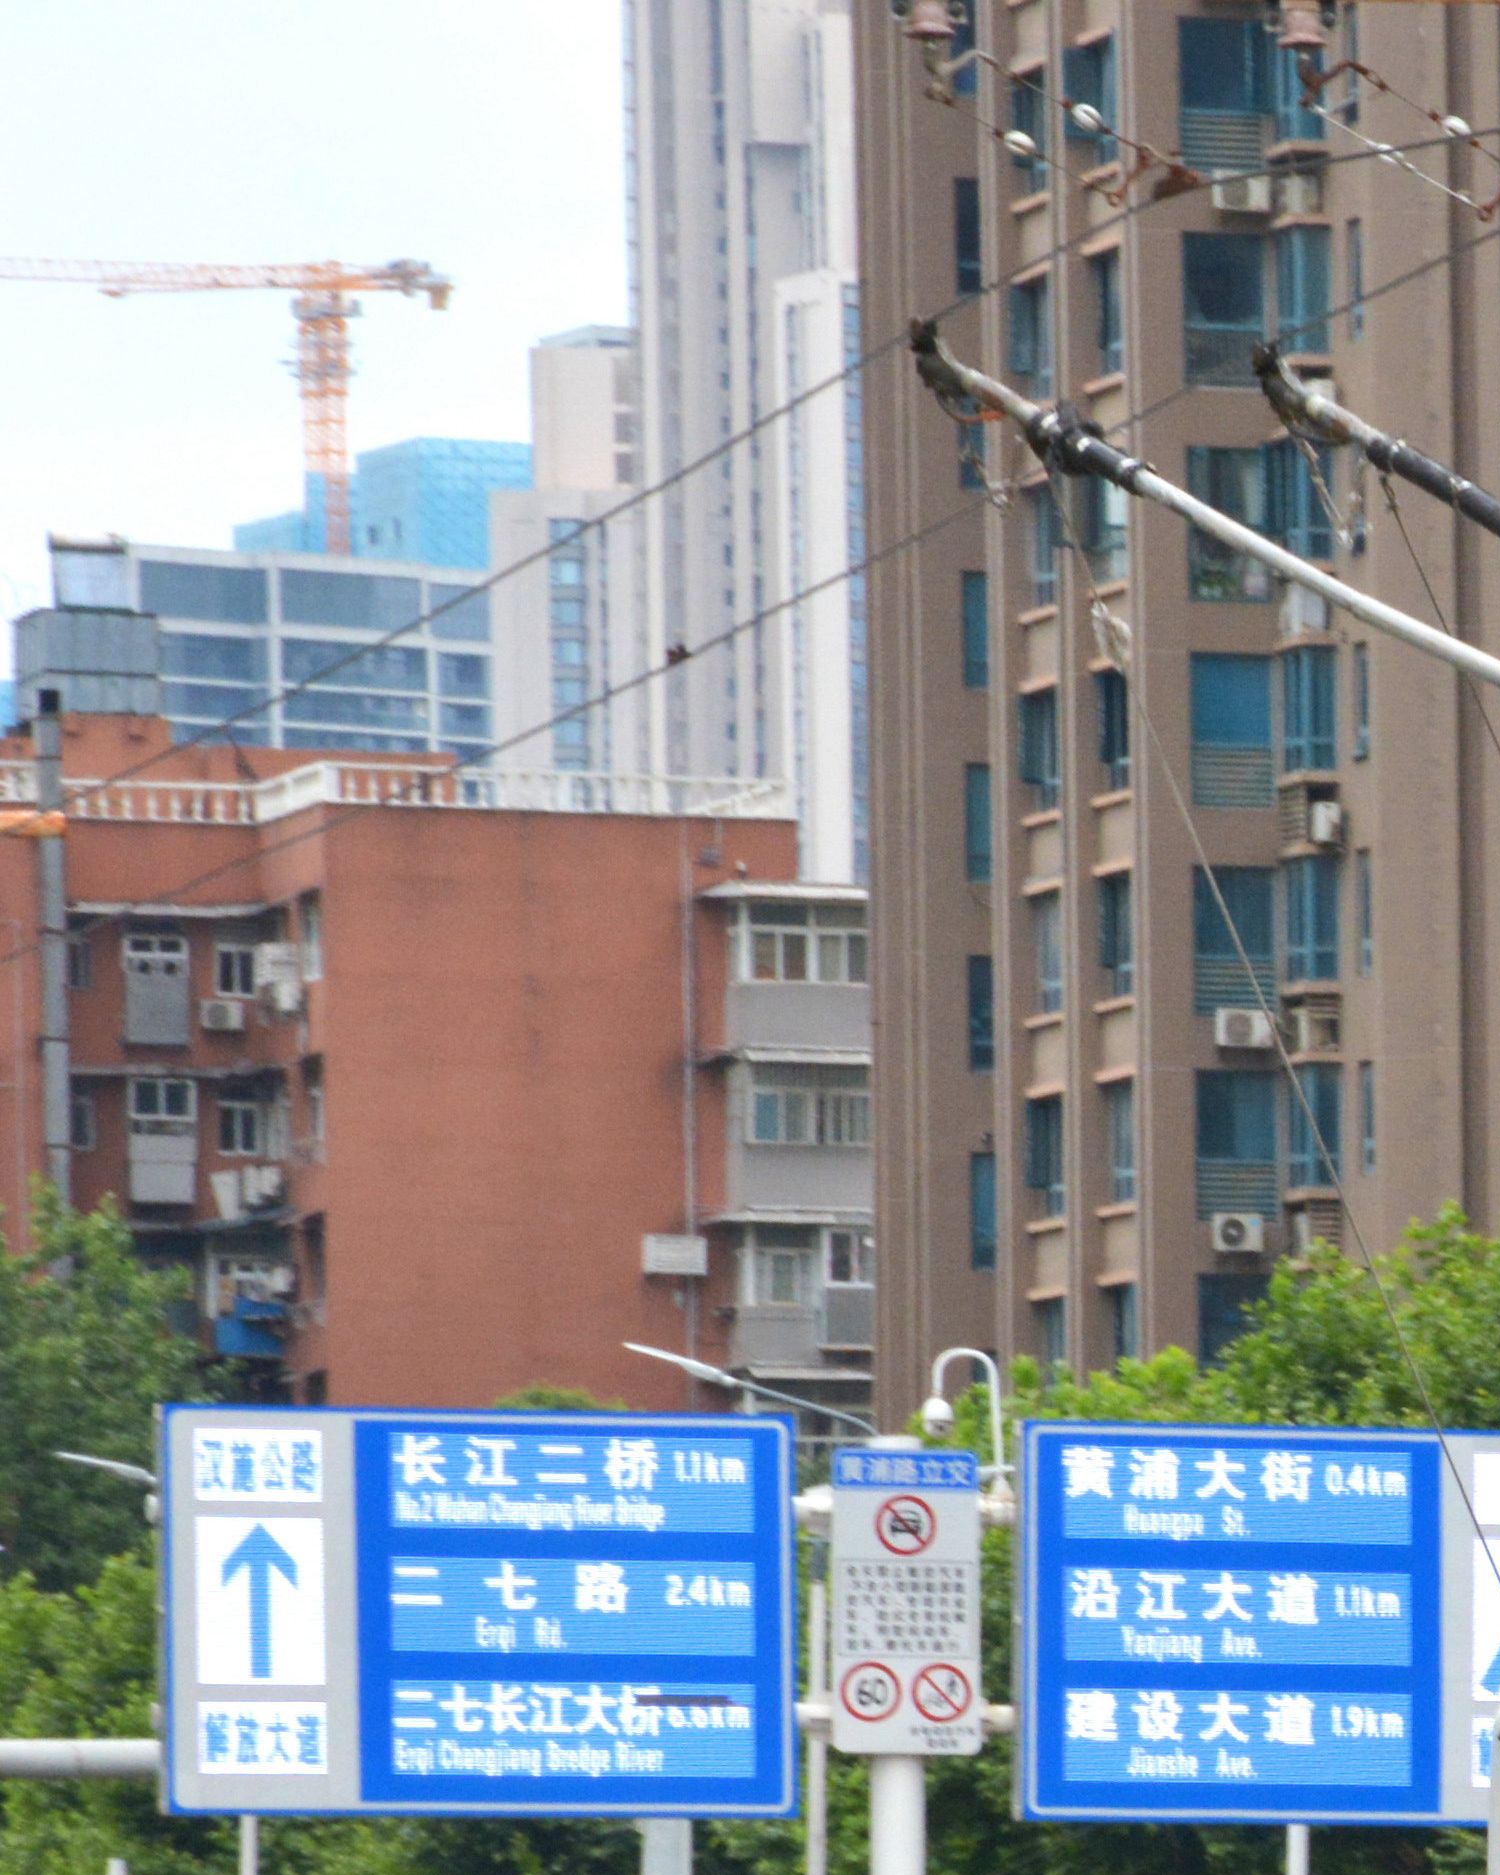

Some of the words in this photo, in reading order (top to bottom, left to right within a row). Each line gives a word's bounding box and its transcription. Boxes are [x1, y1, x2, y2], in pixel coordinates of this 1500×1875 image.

[393, 1435, 659, 1490] 长江二桥
[674, 1451, 746, 1483] 1.1km
[1062, 1447, 1312, 1502] 黄浦大街
[1325, 1465, 1407, 1496] 0.4km
[391, 1562, 628, 1613] 二七路
[666, 1575, 751, 1606] 2.4km
[1071, 1569, 1318, 1624] 沿江大道
[393, 1683, 663, 1736] 二七长江大桥
[857, 1678, 888, 1706] 60
[1066, 1691, 1315, 1744] 建设大道
[1331, 1706, 1404, 1737] 1.9km
[205, 1712, 320, 1764] 解放大道
